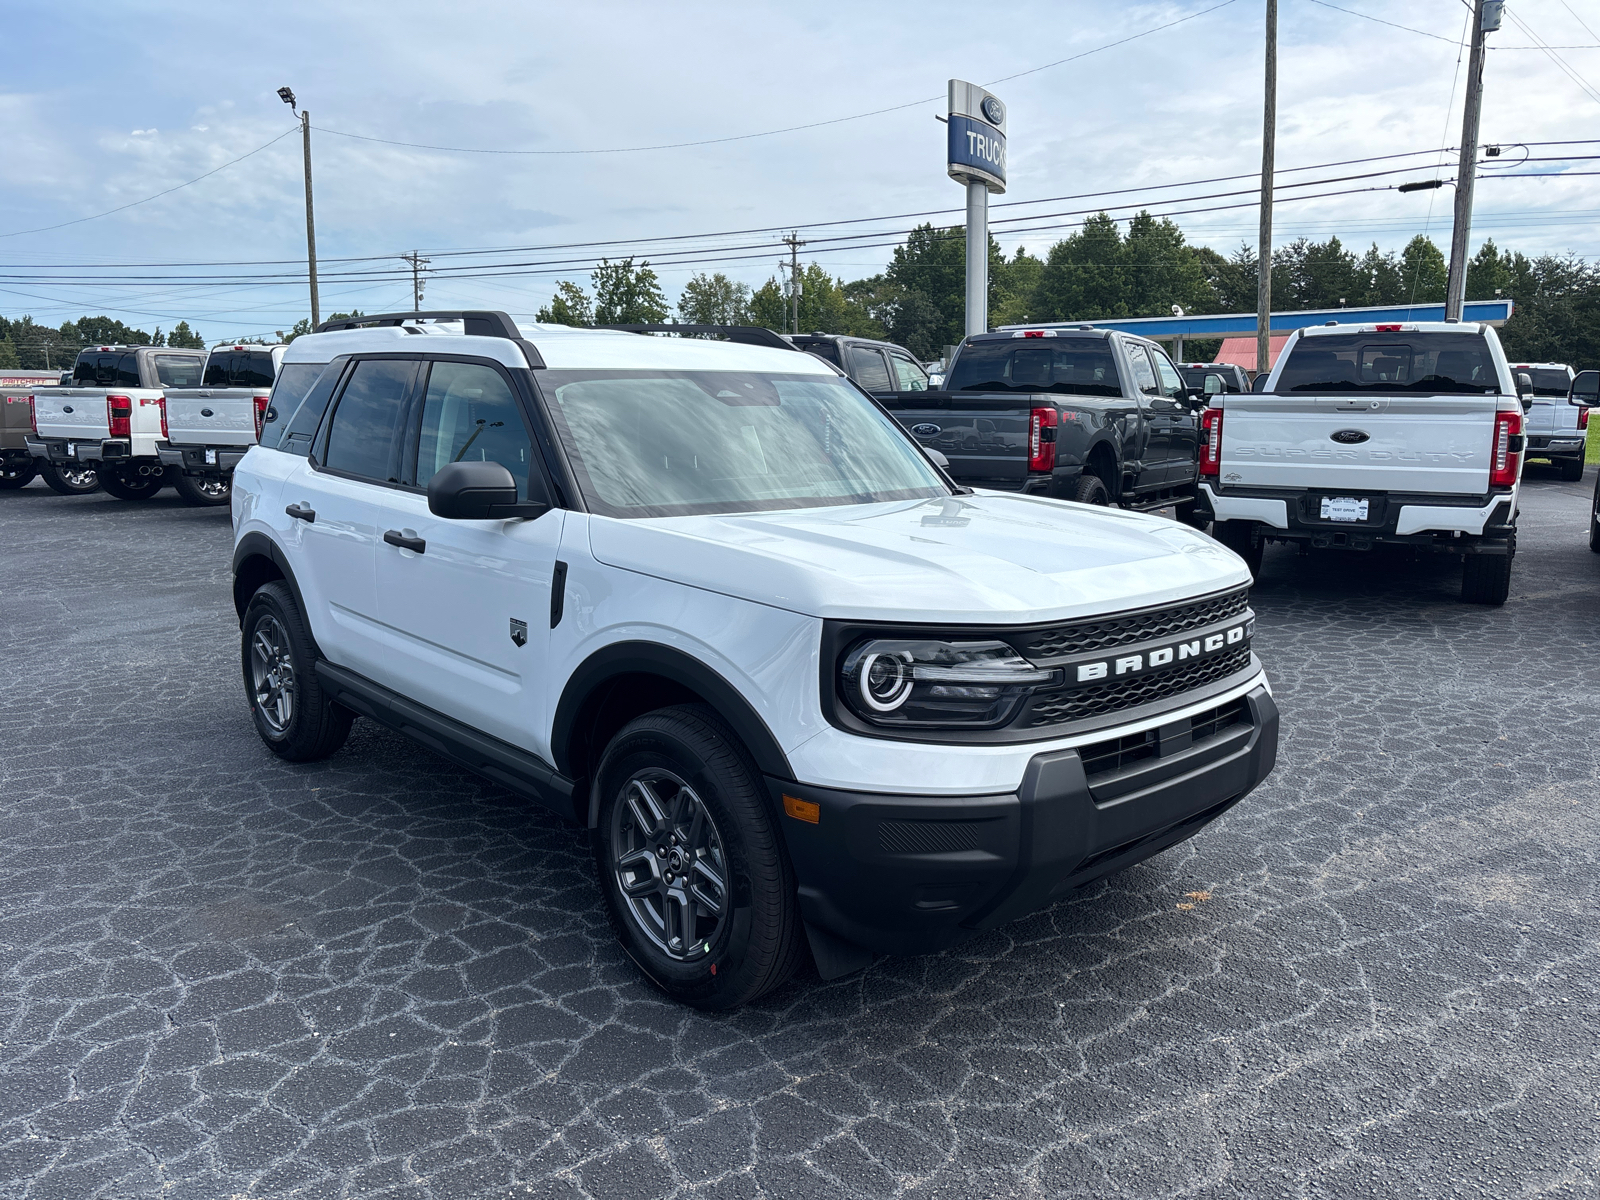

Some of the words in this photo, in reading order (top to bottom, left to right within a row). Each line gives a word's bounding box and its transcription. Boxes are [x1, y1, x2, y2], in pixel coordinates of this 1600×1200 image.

[1235, 447, 1358, 460] SUPER
[1369, 450, 1475, 463] DUTY
[1077, 626, 1243, 682] BRONCO
